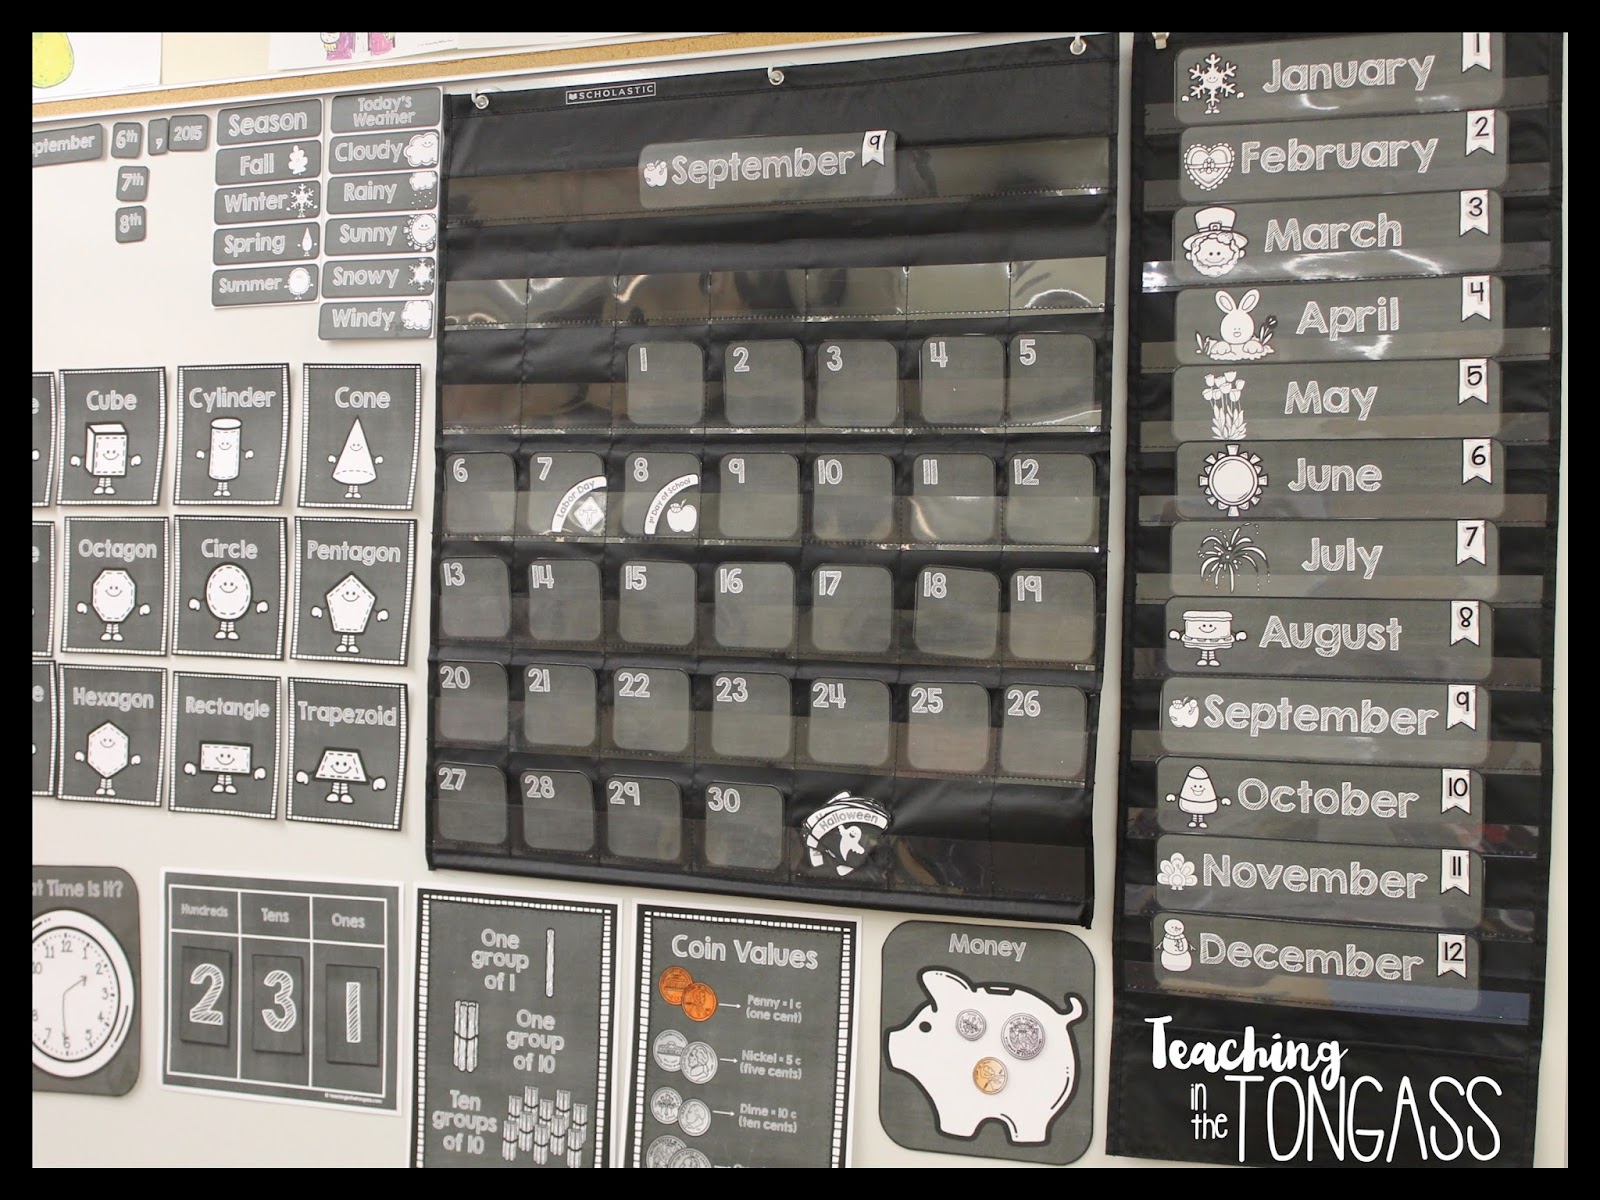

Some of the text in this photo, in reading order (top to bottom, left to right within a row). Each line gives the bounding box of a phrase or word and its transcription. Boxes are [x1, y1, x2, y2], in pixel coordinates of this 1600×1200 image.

[1474, 32, 1482, 53] 1
[1262, 54, 1436, 93] January
[357, 94, 412, 113] Today's
[578, 83, 654, 100] SCHOLASTIC
[228, 108, 308, 137] Season
[353, 108, 416, 128] Weather
[1474, 115, 1490, 138] 2
[32, 135, 95, 157] ptember
[115, 129, 138, 149] 6th
[174, 125, 202, 142] 2015
[335, 137, 403, 163] Cloudy
[868, 134, 882, 151] 9
[239, 152, 275, 176] Fall
[1241, 137, 1439, 175] February
[671, 147, 855, 190] September
[121, 173, 144, 192] 7th
[344, 181, 398, 206] Rainy
[224, 190, 288, 214] Winter
[1468, 196, 1483, 218] 3
[119, 213, 142, 234] 8th
[339, 223, 397, 248] Sunny
[1264, 212, 1403, 253] March
[223, 232, 286, 258] Spring
[219, 275, 282, 294] Summer
[333, 266, 399, 290] Snowy
[1469, 281, 1485, 303] 4
[332, 308, 395, 331] Windy
[1295, 296, 1400, 342] April
[639, 347, 648, 372] 1
[733, 347, 750, 372] 2
[826, 345, 843, 372] 3
[929, 341, 948, 368] 4
[1019, 339, 1036, 366] 5
[1466, 364, 1483, 387] 5
[85, 390, 138, 411] Cube
[188, 386, 276, 413] Cylinder
[334, 386, 391, 409] Cone
[1284, 380, 1378, 421] May
[1470, 444, 1486, 466] 6
[453, 458, 468, 482] 6
[537, 456, 553, 481] 7
[633, 457, 649, 482] 8
[728, 458, 745, 483] 9
[817, 459, 843, 485] 10
[923, 459, 938, 485] 11
[1013, 459, 1040, 486] 12
[1287, 457, 1383, 492] June
[556, 480, 595, 518] Labor Day
[651, 500, 663, 515] Day
[667, 477, 691, 494] School
[1466, 525, 1479, 548] 7
[78, 539, 157, 563] Octagon
[201, 538, 258, 560] Circle
[307, 540, 401, 566] Pentagon
[1301, 536, 1383, 580] July
[443, 562, 465, 586] 13
[532, 564, 554, 589] 14
[625, 565, 647, 590] 15
[720, 568, 743, 594] 16
[819, 570, 842, 596] 17
[923, 571, 947, 598] 18
[1017, 575, 1042, 602] 19
[1459, 606, 1473, 628] 8
[1258, 614, 1402, 658] August
[440, 666, 470, 689] 20
[528, 668, 551, 692] 21
[618, 672, 651, 698] 22
[715, 677, 748, 702] 23
[72, 687, 154, 713] Hexagon
[812, 682, 846, 709] 24
[911, 687, 944, 714] 25
[1007, 689, 1041, 717] 26
[1456, 690, 1470, 714] 9
[185, 696, 270, 720] Rectangle
[298, 701, 397, 728] Trapezoid
[1203, 693, 1439, 737] September
[438, 767, 466, 791] 27
[524, 775, 555, 799] 28
[1448, 776, 1468, 797] 10
[608, 780, 640, 806] 29
[707, 787, 741, 813] 30
[1237, 777, 1420, 819] October
[819, 811, 878, 831] Halloween
[1203, 853, 1428, 899] November
[1451, 855, 1463, 878] 11
[46, 879, 85, 897] Time
[103, 880, 123, 898] It?
[181, 903, 228, 919] Hundreds
[261, 908, 289, 924] Tens
[331, 912, 365, 929] Ones
[61, 940, 73, 953] 12
[480, 928, 520, 950] One
[948, 933, 1027, 962] Money
[45, 946, 55, 958] 11
[82, 947, 87, 959] 1
[471, 950, 529, 973] group
[671, 934, 819, 970] Coin Values
[1200, 932, 1424, 981] December
[1443, 941, 1465, 963] 12
[95, 963, 103, 975] 2
[484, 972, 516, 991] of 1
[102, 988, 109, 1000] 3
[189, 963, 224, 1026] 2
[261, 969, 297, 1032] 3
[747, 994, 781, 1010] Penny
[97, 1012, 104, 1022] 4
[345, 981, 361, 1043] 1
[516, 1008, 556, 1031] One
[746, 1006, 802, 1024] (one cent)
[45, 1028, 52, 1040] 7
[506, 1030, 564, 1053] group
[513, 1053, 556, 1074] of 10
[742, 1049, 777, 1064] Nickel
[785, 1054, 793, 1065] 5
[740, 1062, 802, 1080] (five cents)
[449, 1090, 481, 1112] Ten
[740, 1103, 769, 1116] Dime
[778, 1107, 789, 1119] 10
[432, 1110, 498, 1133] groups
[738, 1115, 798, 1134] (ten cents)
[442, 1133, 485, 1154] of 10
